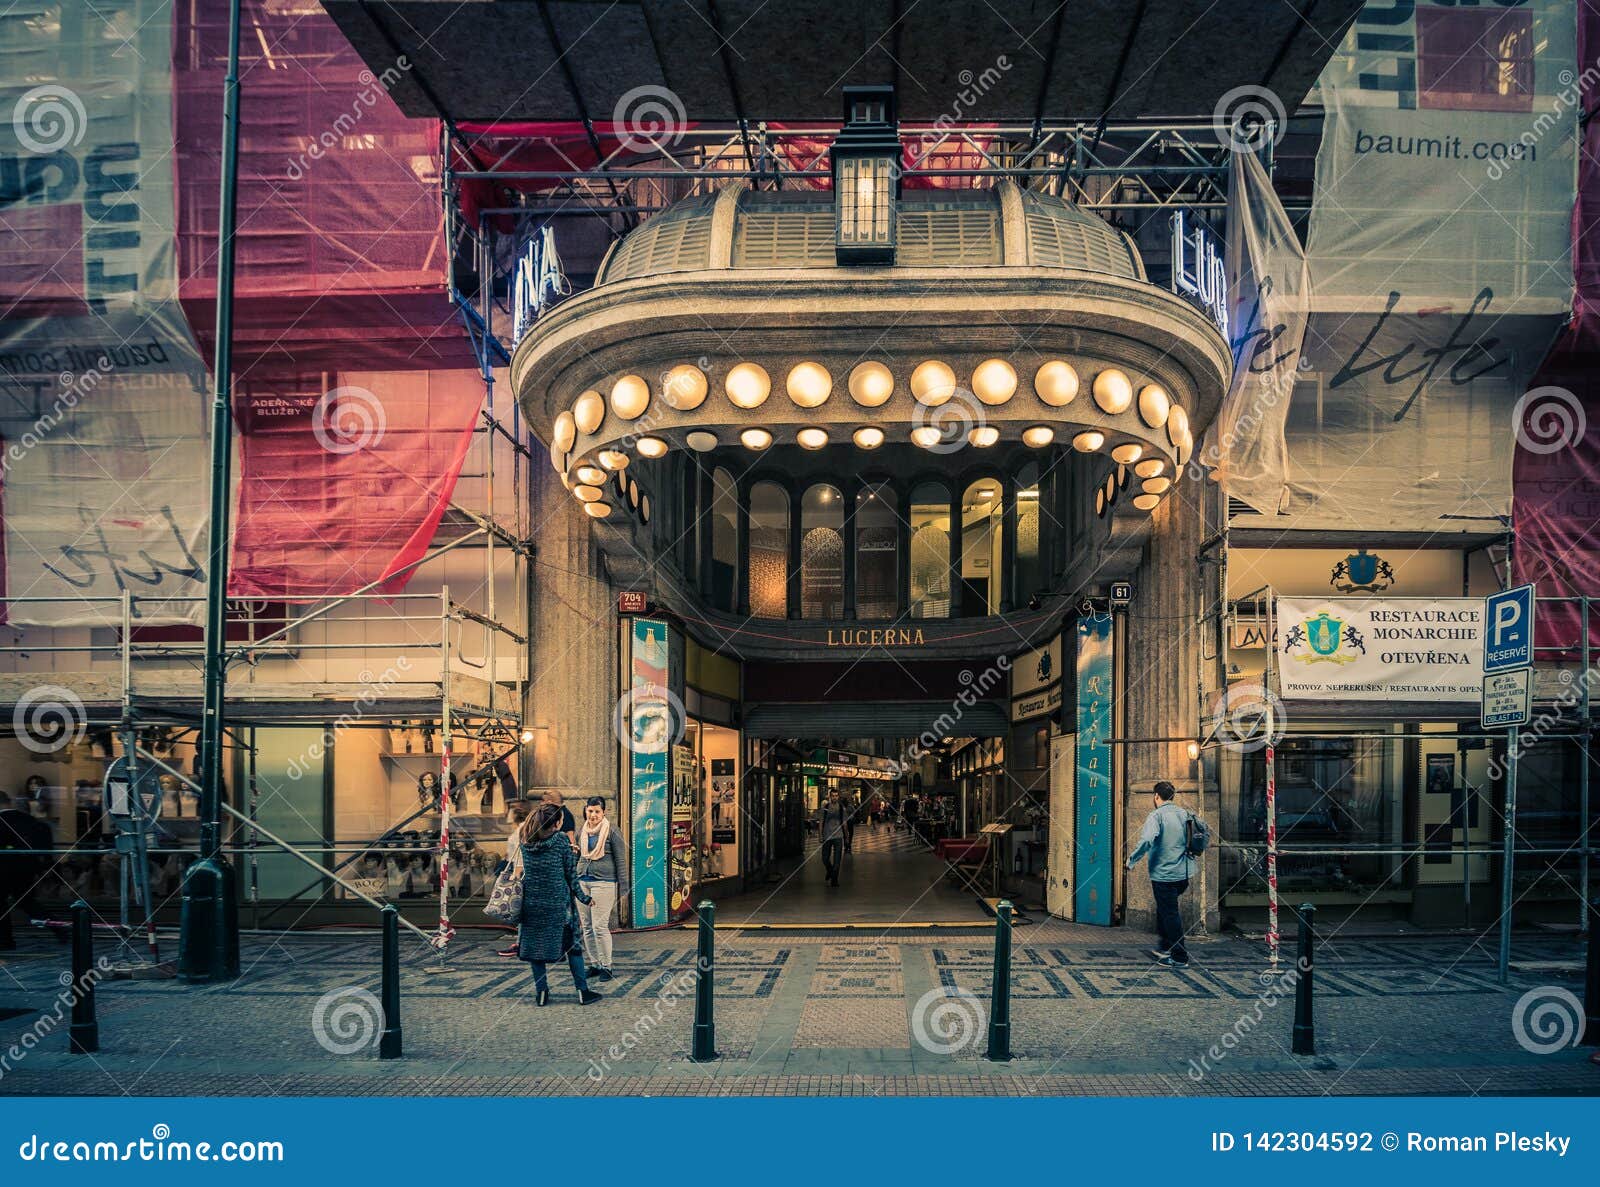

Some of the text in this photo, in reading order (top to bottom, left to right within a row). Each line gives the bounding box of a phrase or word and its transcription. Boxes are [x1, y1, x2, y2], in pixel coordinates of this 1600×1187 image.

[1354, 129, 1537, 162] baumit.com
[624, 593, 641, 602] 704
[1116, 587, 1127, 597] 61
[1369, 610, 1480, 623] RESTAURACE
[1494, 600, 1521, 646] P
[827, 629, 925, 646] LUCERNA
[1373, 628, 1478, 640] MONARCHIE
[1380, 649, 1471, 665] OTEVŘENA
[1287, 683, 1322, 691] PROVOZ
[1390, 685, 1446, 693] RESTAURANT
